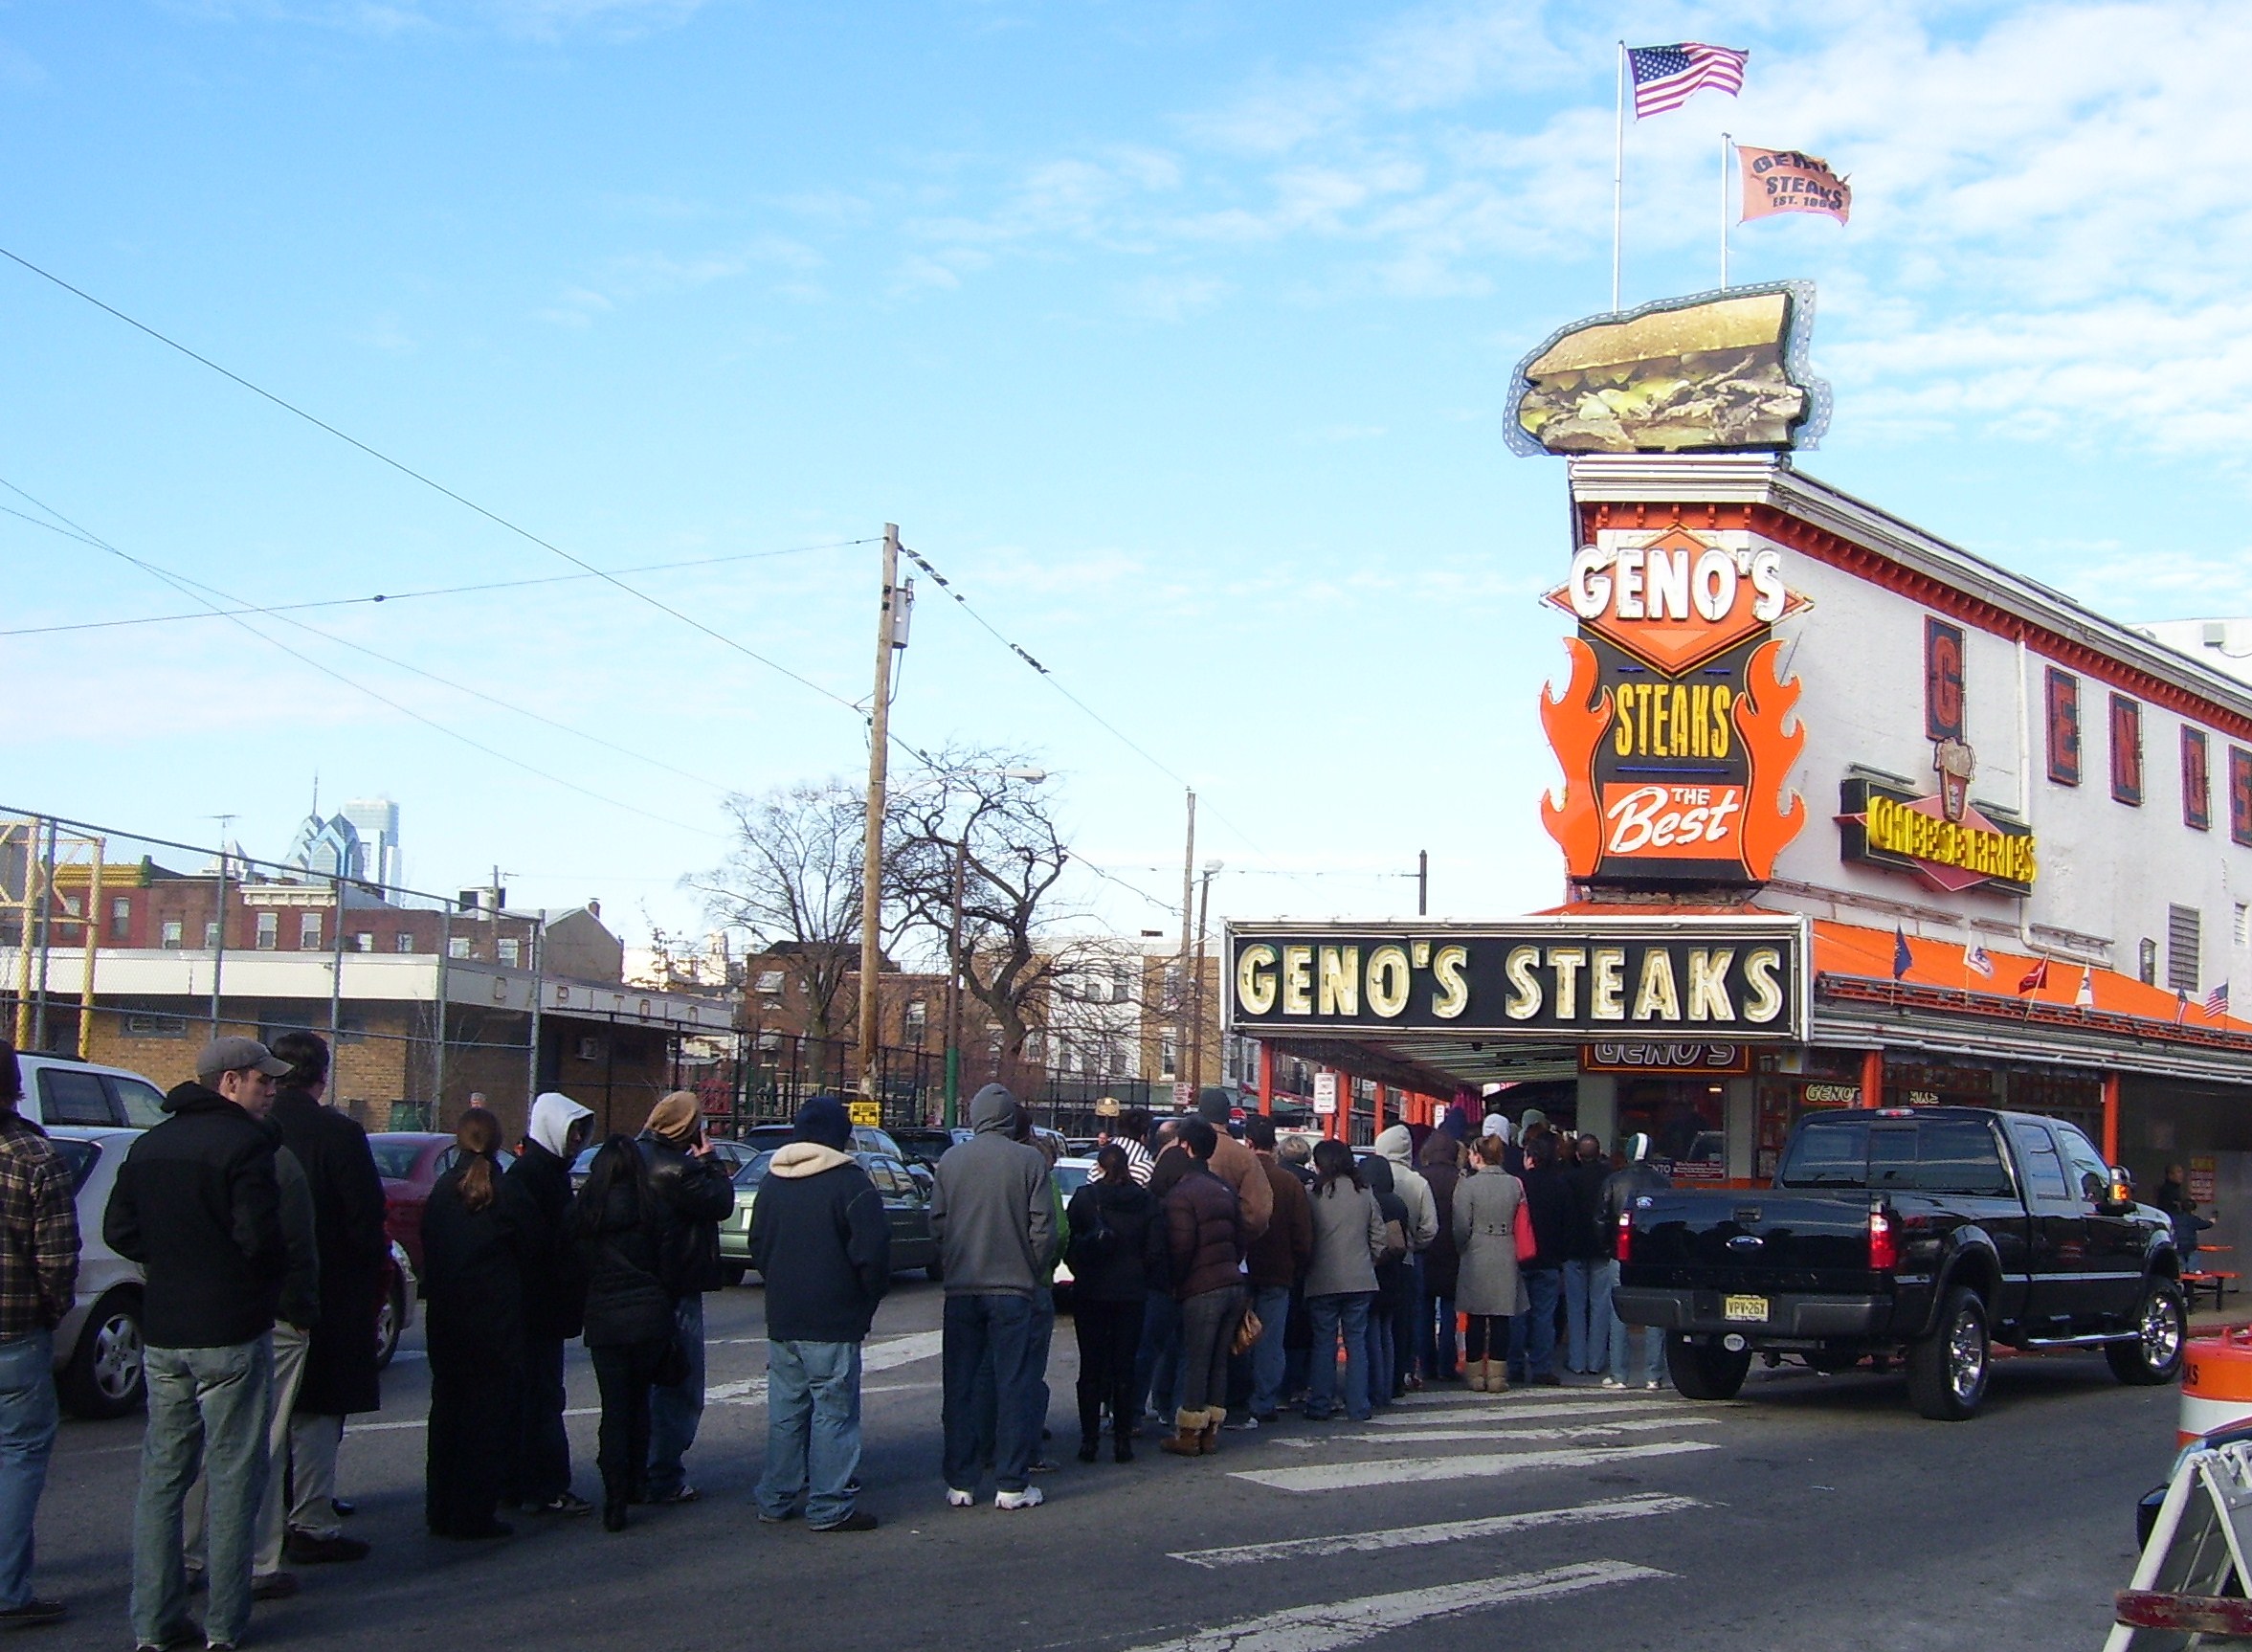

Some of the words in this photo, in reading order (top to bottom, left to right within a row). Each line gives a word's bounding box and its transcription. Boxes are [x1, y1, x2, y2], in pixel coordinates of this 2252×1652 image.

[1766, 176, 1842, 210] STEAKS
[1773, 195, 1797, 208] EST.
[1570, 545, 1786, 622] GENO'S
[1615, 683, 1731, 758] STEAKS
[1607, 786, 1740, 853] Best
[1670, 787, 1711, 806] THE
[1868, 796, 1965, 867] CHEESE
[1966, 829, 2036, 882] FRIES
[1237, 940, 1469, 1018] GENO'S
[1505, 944, 1783, 1023] STEAKS
[1594, 1043, 1735, 1066] GENOS
